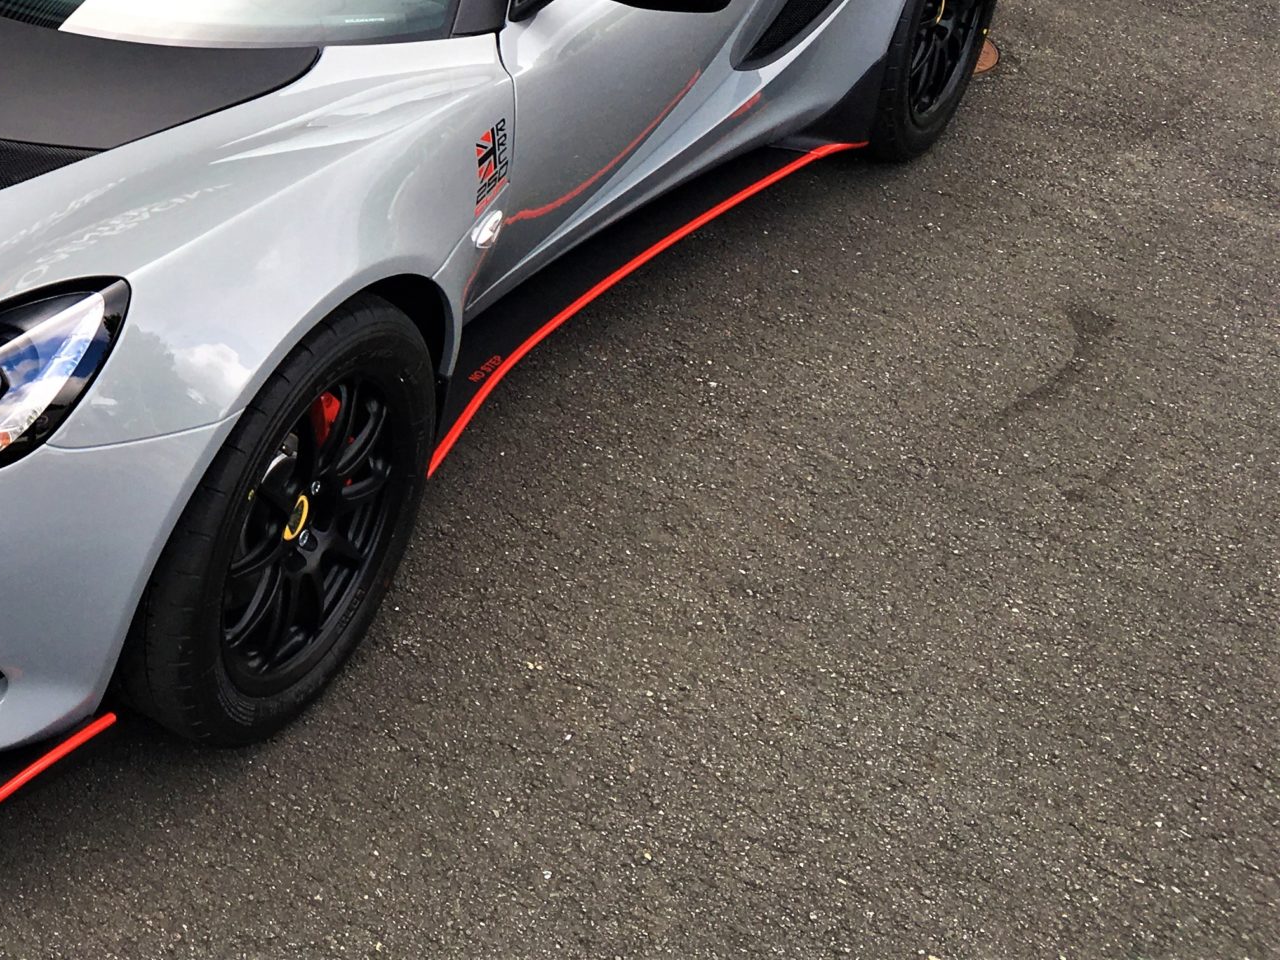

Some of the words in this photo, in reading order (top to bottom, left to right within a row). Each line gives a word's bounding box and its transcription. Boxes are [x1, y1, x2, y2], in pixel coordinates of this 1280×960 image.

[476, 160, 509, 206] 250
[468, 370, 486, 382] NO
[480, 354, 502, 372] STEP
